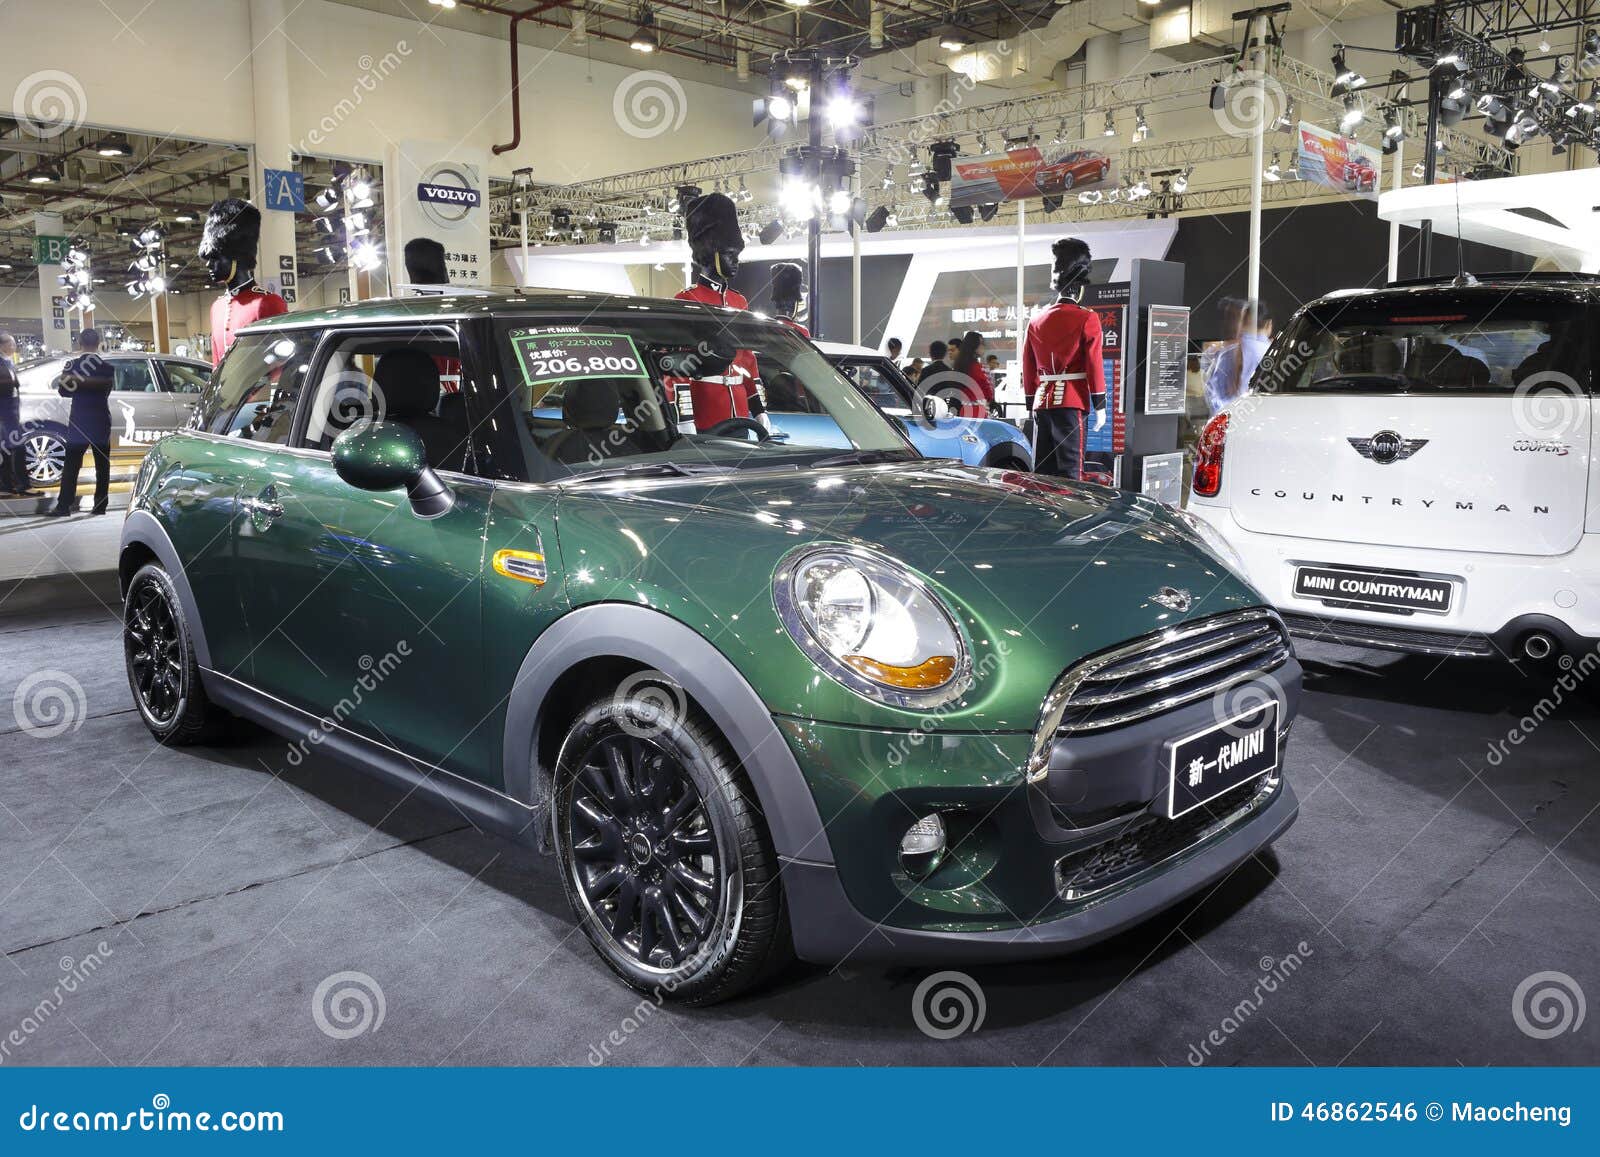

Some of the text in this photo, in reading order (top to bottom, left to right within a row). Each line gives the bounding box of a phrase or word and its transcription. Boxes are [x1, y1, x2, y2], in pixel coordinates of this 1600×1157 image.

[277, 175, 295, 206] A
[424, 187, 477, 202] VOLVO
[48, 239, 62, 261] B
[533, 356, 638, 376] 206,800
[1374, 442, 1399, 452] MINI
[1250, 488, 1550, 514] COUNTRYMAN
[1303, 575, 1444, 602] MINI COUNTRYMAN
[1189, 728, 1265, 787] 新一代MINI
